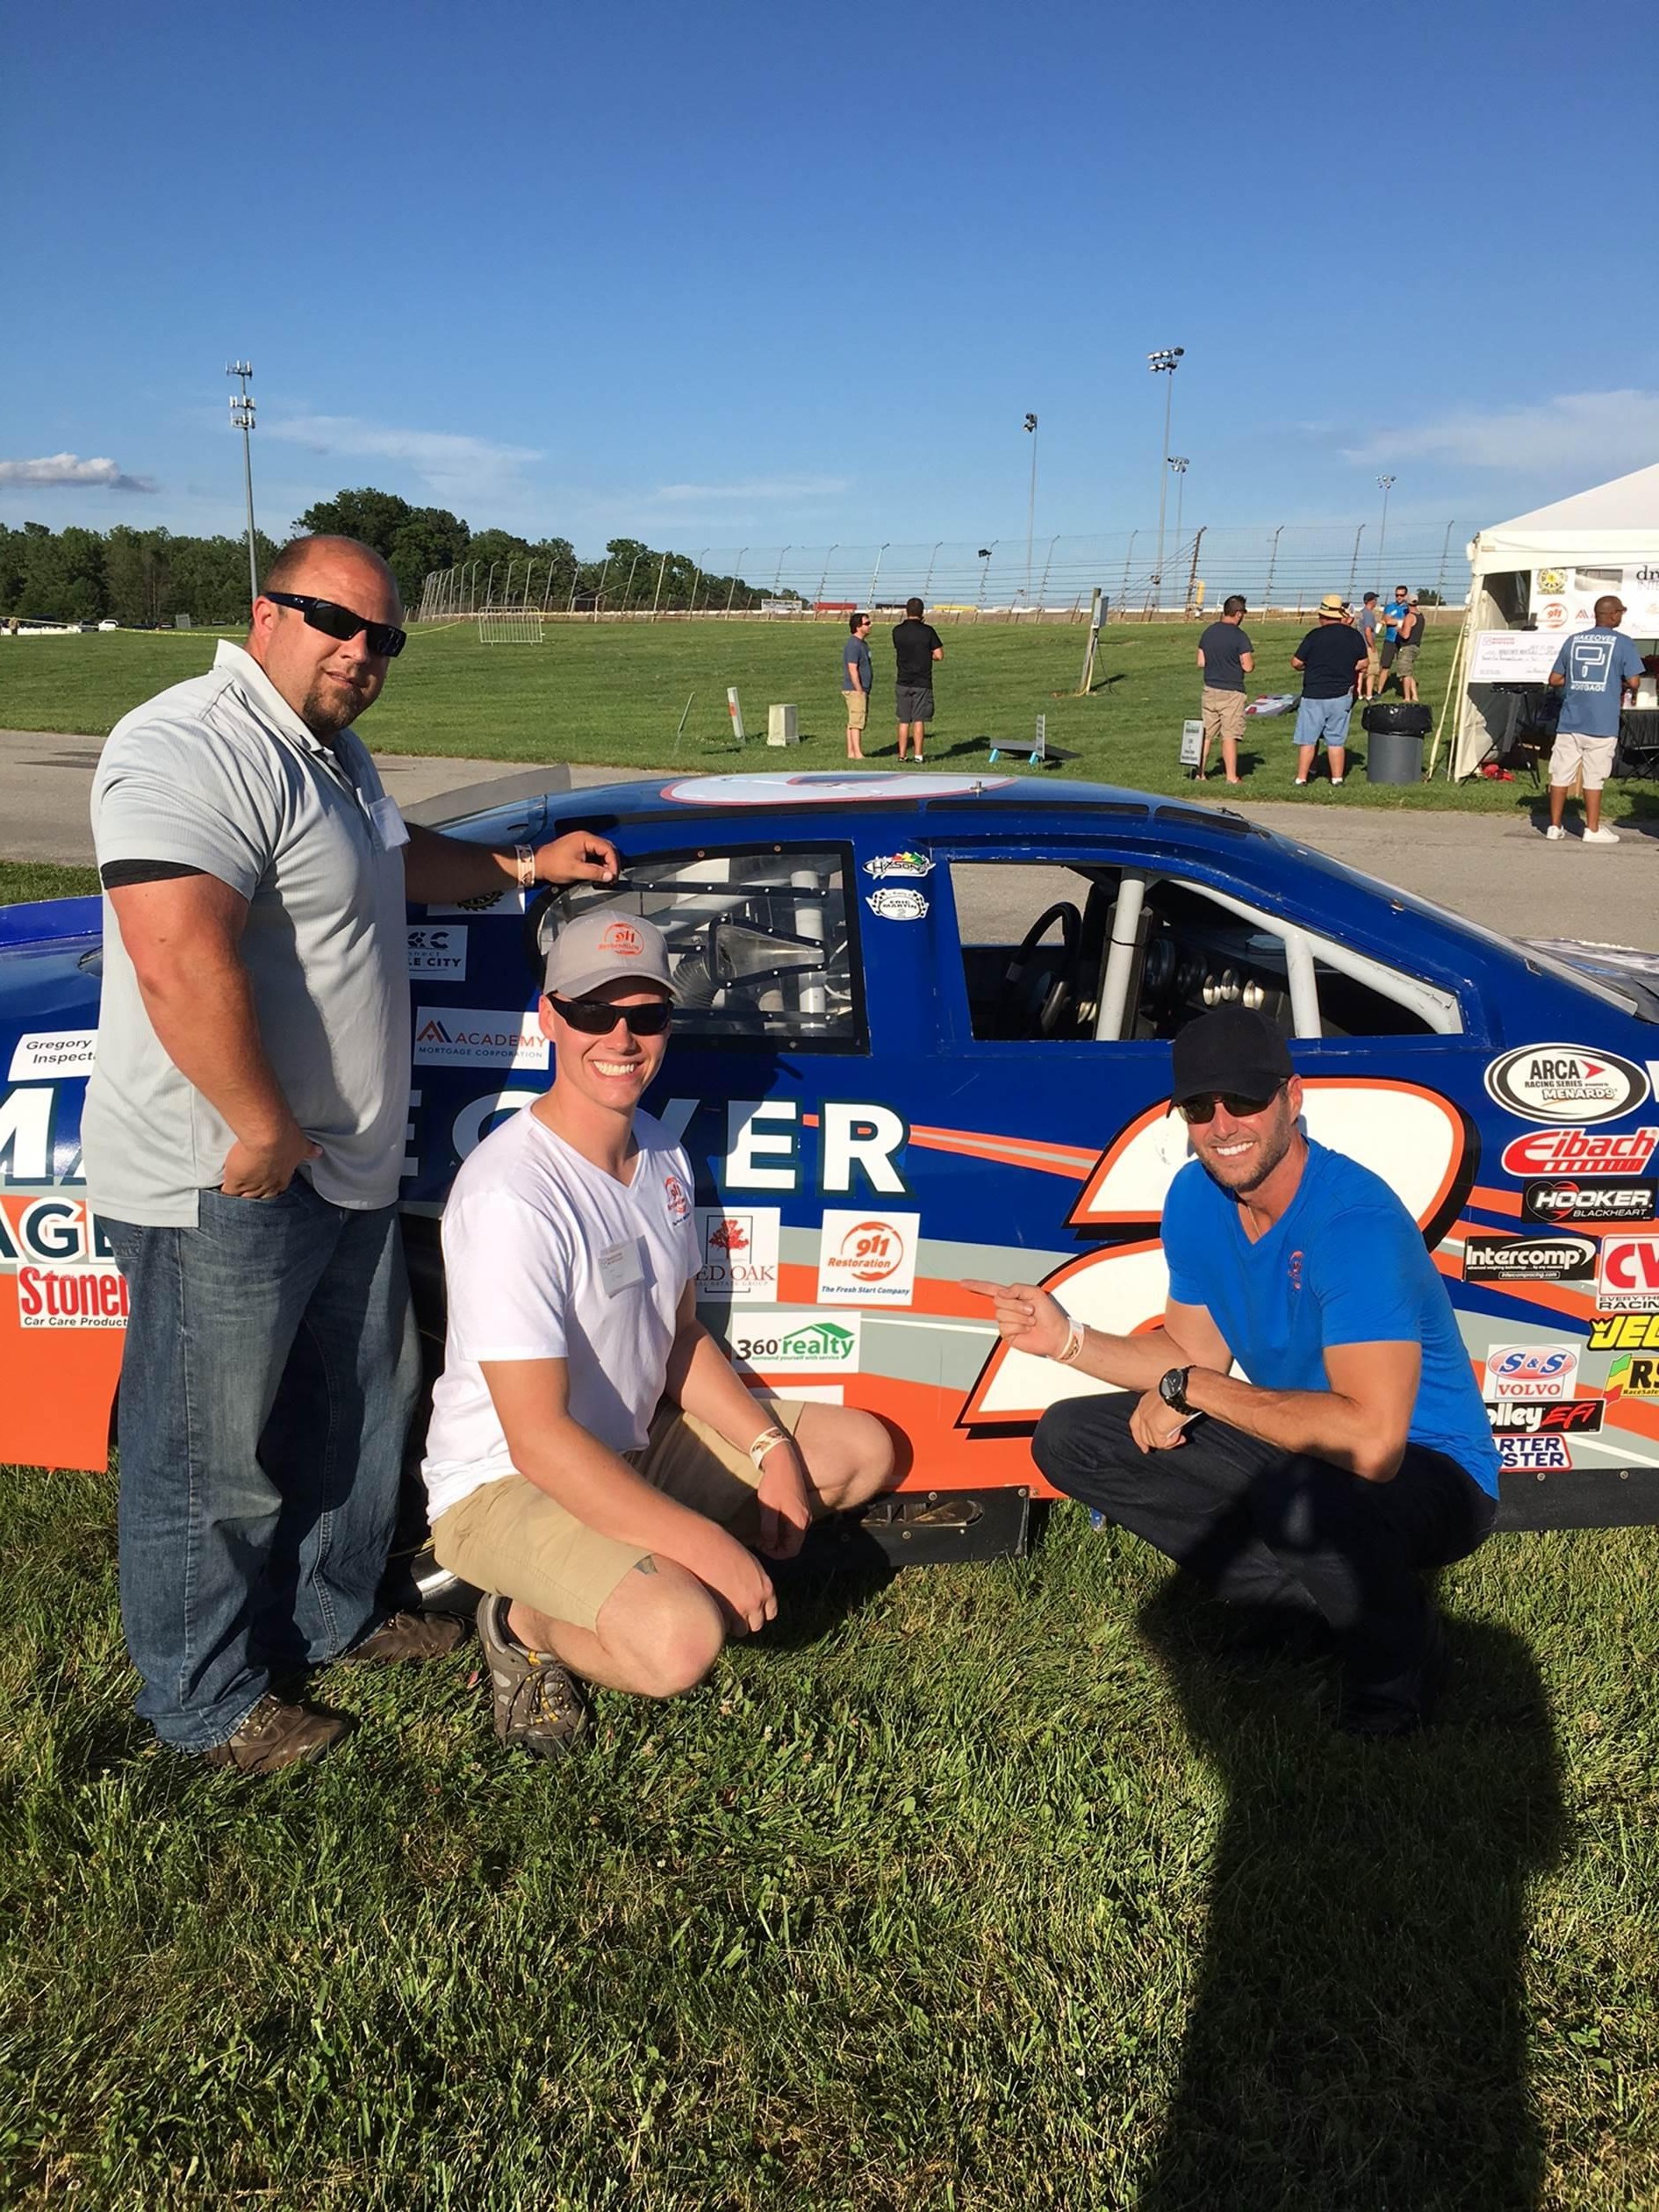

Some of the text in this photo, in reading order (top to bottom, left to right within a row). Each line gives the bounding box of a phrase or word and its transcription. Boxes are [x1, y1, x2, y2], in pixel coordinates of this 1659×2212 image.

[1574, 634, 1617, 643] MAKEOVER
[427, 957, 462, 967] CITY
[26, 1039, 92, 1051] Gregory
[455, 1032, 546, 1047] ACADEMY
[32, 1052, 97, 1065] Inspect
[419, 1046, 542, 1059] MORTGAGE CORPORATION
[1529, 1059, 1581, 1081] ARCA
[1542, 1088, 1615, 1101] MENARDS
[1504, 1129, 1655, 1174] Eibach
[1572, 1208, 1648, 1218] BLACKHEART
[856, 1234, 890, 1258] 911
[828, 1257, 892, 1268] Restoration
[1466, 1245, 1581, 1270] Intercomp
[730, 1265, 776, 1281] OAK
[877, 1287, 910, 1296] Company
[24, 1316, 46, 1326] Car
[48, 1317, 77, 1326] Care
[782, 1333, 855, 1360] realty
[1497, 1383, 1562, 1396] VOLVO
[1541, 1402, 1598, 1429] EFI
[1493, 1437, 1561, 1452] RTER
